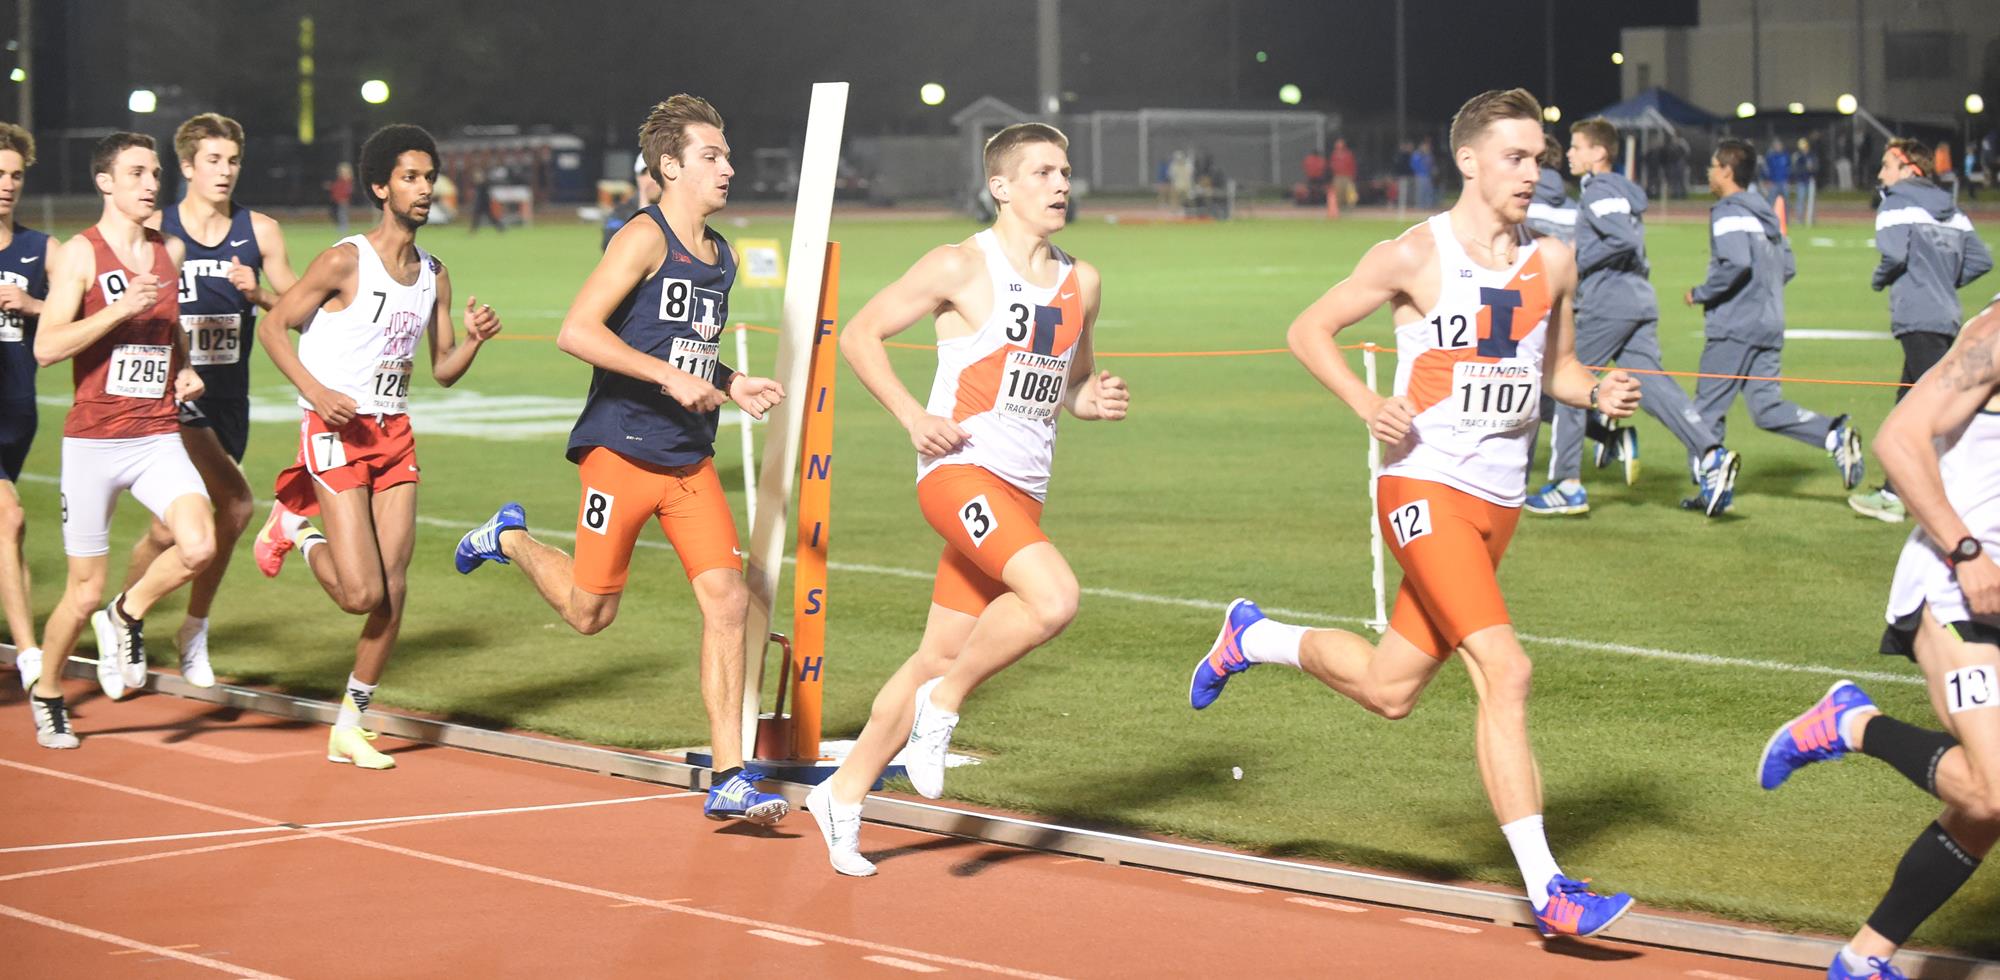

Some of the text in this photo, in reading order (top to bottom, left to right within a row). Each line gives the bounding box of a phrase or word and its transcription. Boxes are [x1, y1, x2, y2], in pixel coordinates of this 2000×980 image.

[107, 274, 127, 302] 9
[666, 281, 688, 318] 8
[373, 291, 387, 324] 7
[1006, 303, 1030, 342] 3
[187, 328, 237, 351] 1025
[1431, 314, 1469, 348] 12
[679, 341, 720, 355] ILLINOIS
[1014, 353, 1067, 371] ILLINOIS
[117, 359, 168, 384] 1295
[374, 372, 410, 398] 126
[1008, 369, 1064, 404] 1089
[1463, 365, 1529, 378] ILLINOIS
[1005, 402, 1051, 417] TRACK & FIELD
[1461, 383, 1532, 413] 1107
[319, 434, 334, 467] 7
[586, 493, 607, 529] 8
[800, 319, 834, 683] FINISH
[964, 502, 990, 539] 3
[1394, 505, 1422, 543] 12
[1950, 669, 1990, 708] 13
